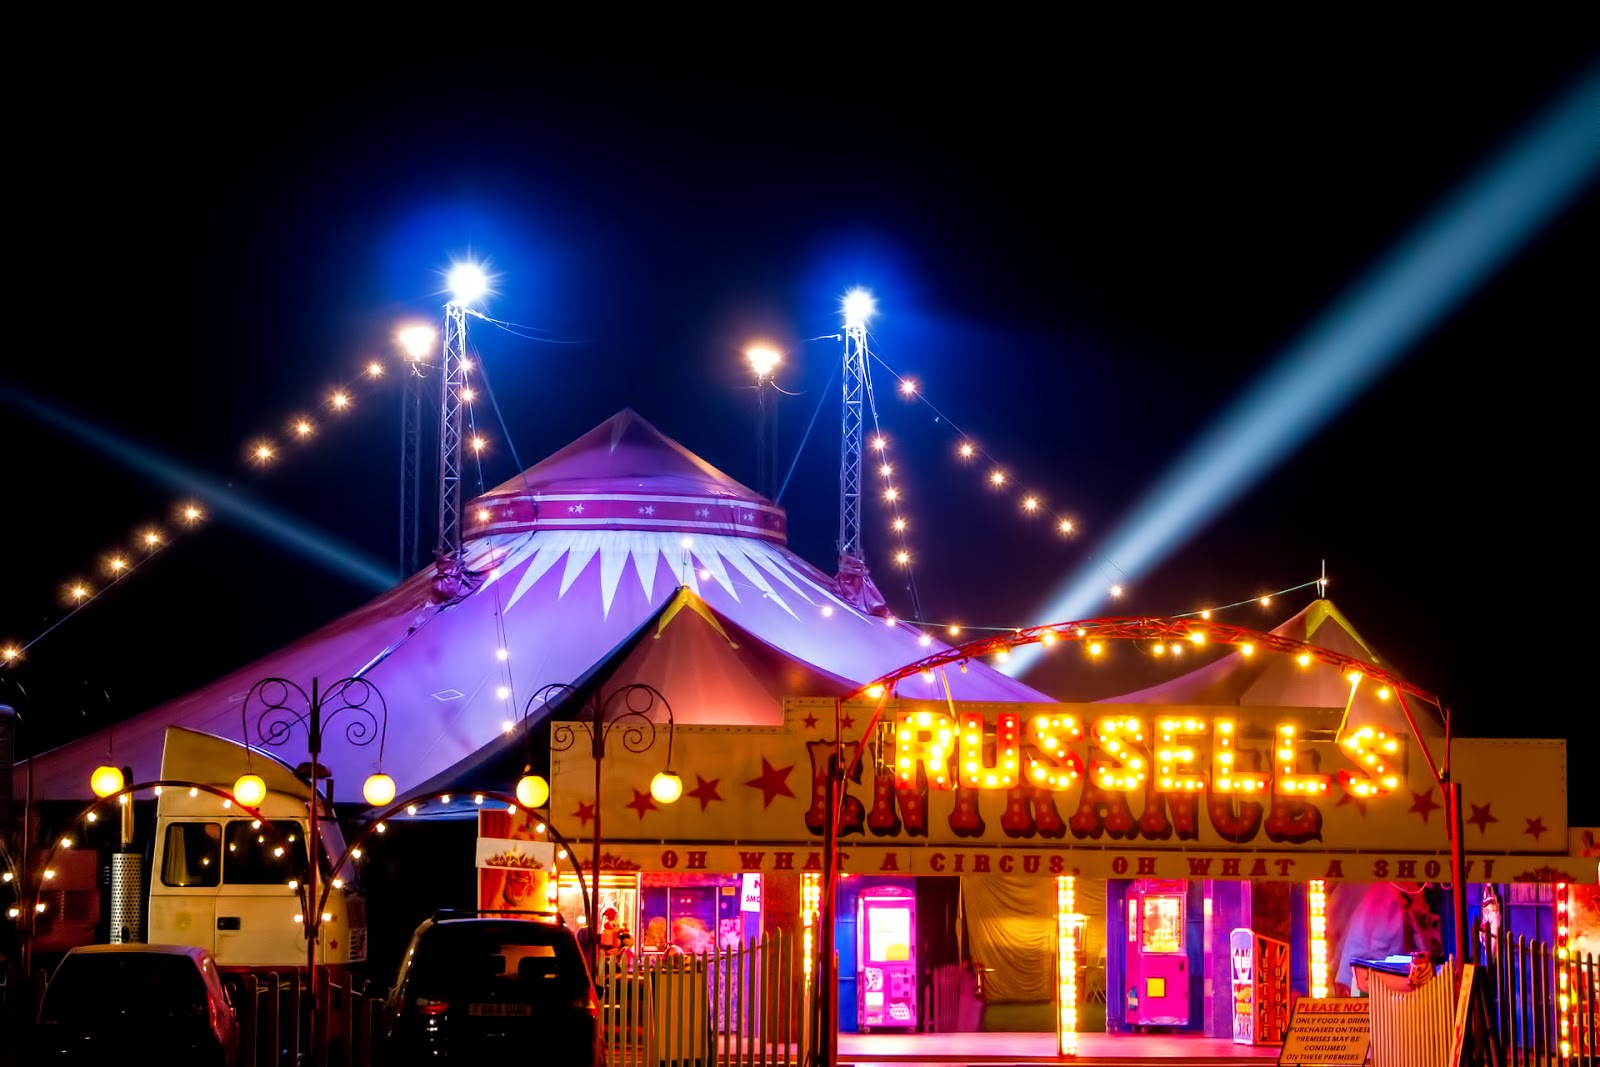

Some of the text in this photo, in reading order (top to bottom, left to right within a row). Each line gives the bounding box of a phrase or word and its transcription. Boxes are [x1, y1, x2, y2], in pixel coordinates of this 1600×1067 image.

[895, 711, 1405, 799] RUSSELLS
[661, 850, 707, 870] OH
[738, 851, 850, 871] WHAT
[880, 852, 899, 871] A
[930, 853, 1081, 876] CIRCUS,
[1112, 856, 1157, 876] OH
[1187, 857, 1296, 877] WHAT
[1325, 859, 1344, 878] A
[1261, 957, 1269, 1039] SELFIE
[1274, 966, 1282, 1029] BOOTH
[1297, 1003, 1340, 1012] PLEASE
